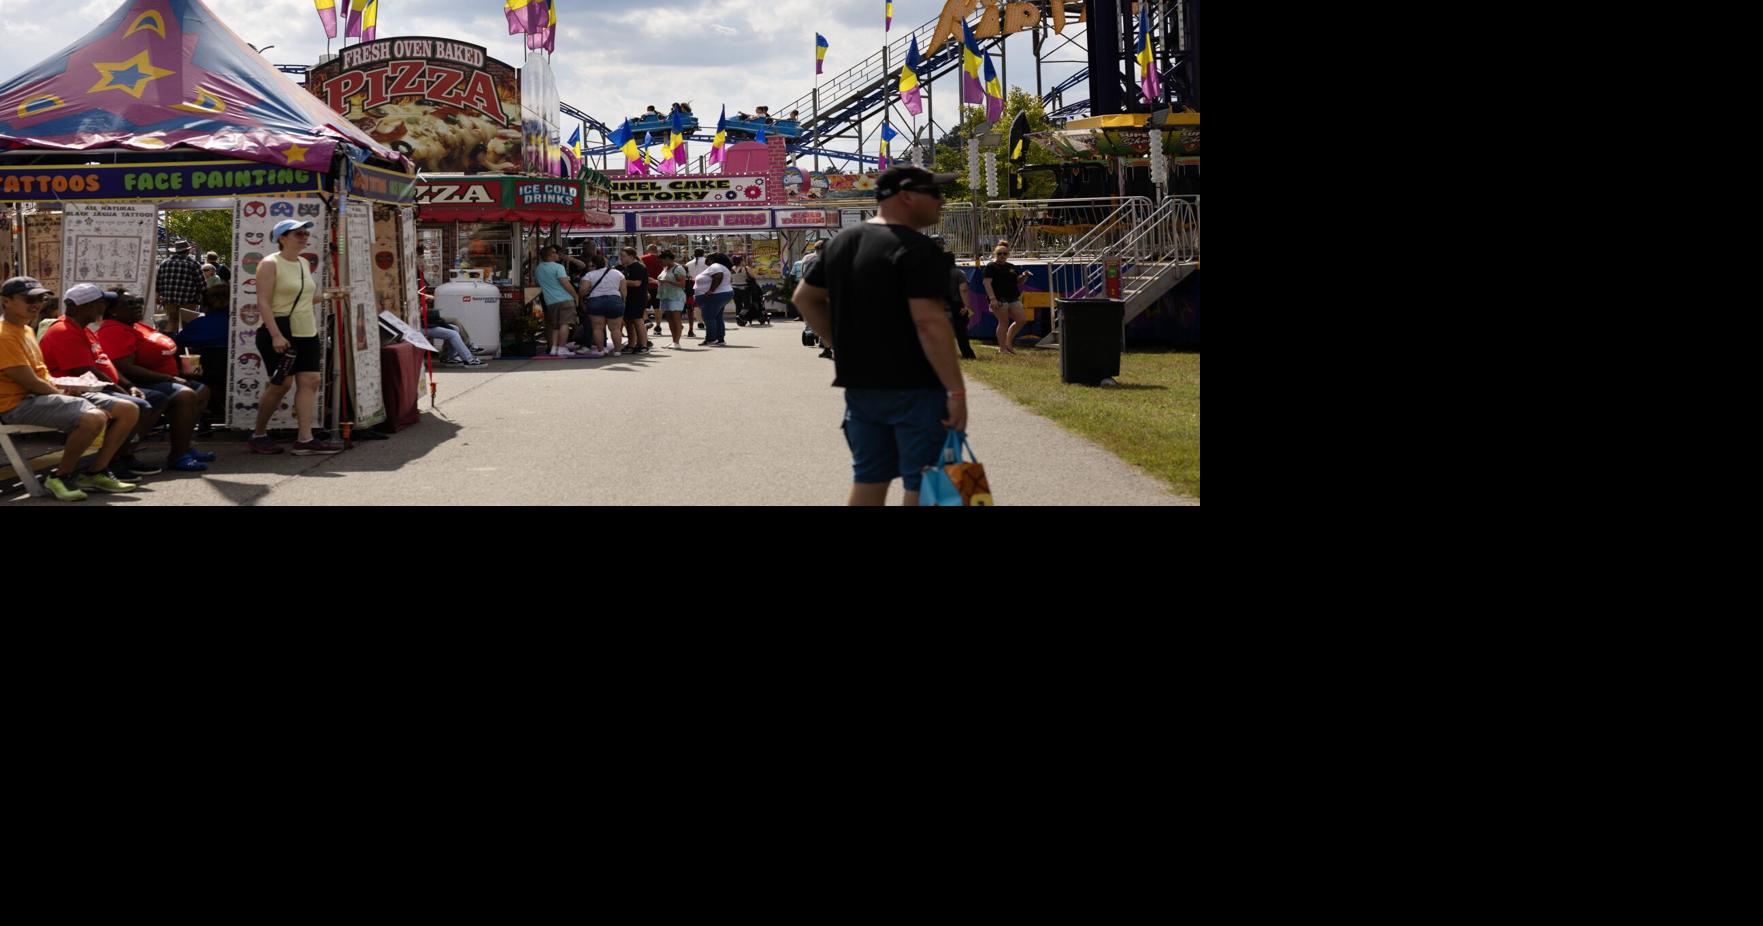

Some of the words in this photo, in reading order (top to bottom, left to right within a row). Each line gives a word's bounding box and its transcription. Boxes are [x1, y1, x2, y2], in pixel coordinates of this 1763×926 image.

[343, 40, 391, 69] FRESH
[393, 39, 432, 58] OVEN
[434, 40, 484, 68] BAKED
[323, 59, 508, 128] PIZZA
[0, 174, 101, 193] ATTOOS
[124, 172, 183, 191] FACE
[191, 169, 310, 190] PAINTING
[668, 179, 730, 190] CAKE
[519, 184, 540, 196] ICE
[544, 184, 577, 198] COLD
[524, 193, 573, 206] DRINKS
[641, 214, 722, 228] ELEPHANT
[723, 213, 767, 226] EARS
